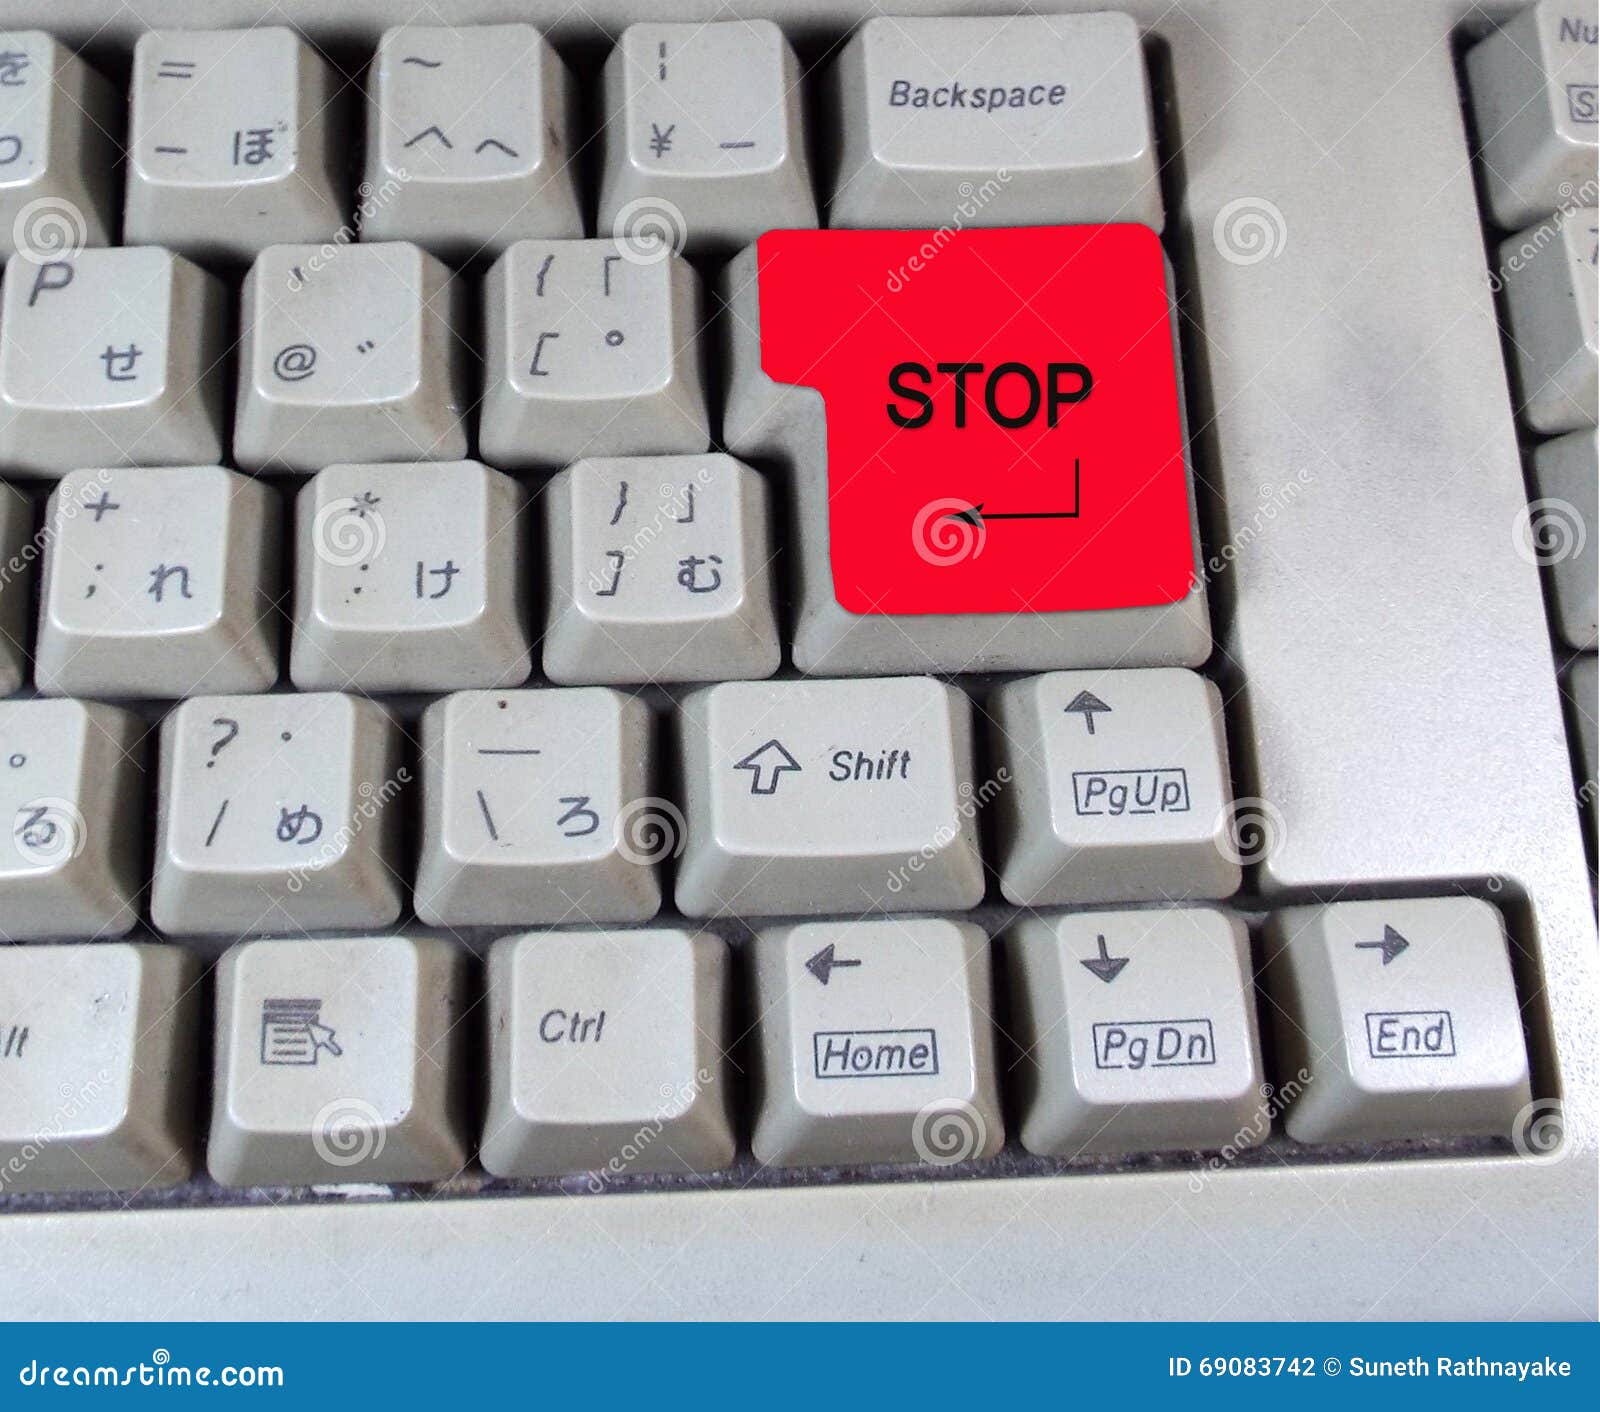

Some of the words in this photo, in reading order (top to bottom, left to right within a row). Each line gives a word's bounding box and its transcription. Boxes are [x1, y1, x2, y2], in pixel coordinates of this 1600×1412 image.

[889, 80, 1066, 113] Backspace
[649, 123, 676, 159] ¥
[29, 261, 74, 308] P
[100, 343, 143, 382] せ
[273, 344, 317, 382] @
[886, 361, 1094, 430] STOP
[148, 564, 193, 603] れ
[416, 560, 460, 599] け
[677, 554, 723, 594] む
[206, 718, 239, 769] ?
[829, 749, 911, 783] Shift
[1084, 775, 1181, 816] PgUp
[276, 804, 323, 845] め
[556, 796, 600, 838] ろ
[0, 1024, 30, 1058] lt
[539, 1009, 606, 1044] Ctrl
[1376, 1018, 1447, 1053] End
[822, 1037, 931, 1072] Home
[1103, 1026, 1207, 1070] PgDn
